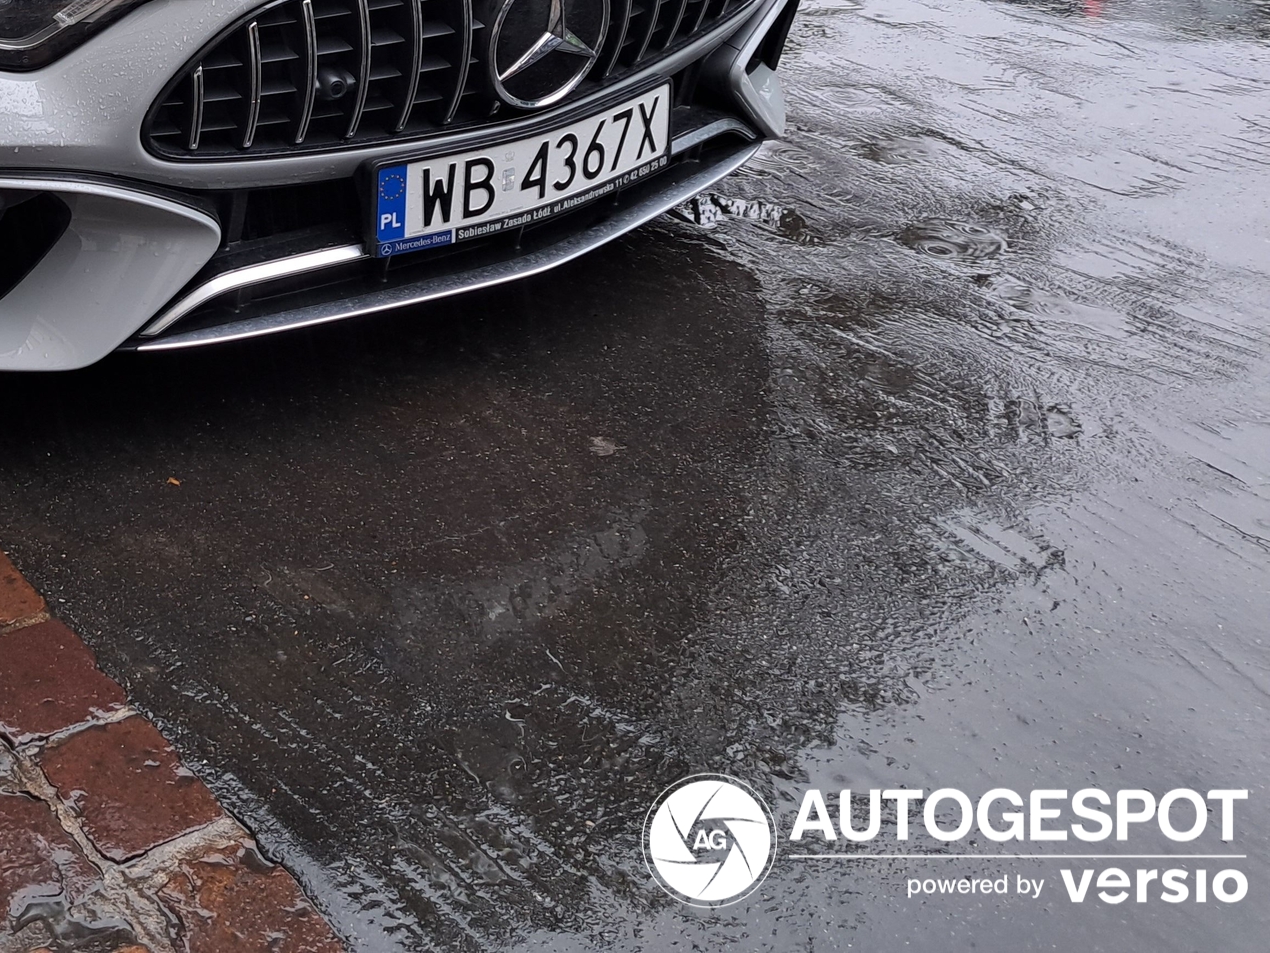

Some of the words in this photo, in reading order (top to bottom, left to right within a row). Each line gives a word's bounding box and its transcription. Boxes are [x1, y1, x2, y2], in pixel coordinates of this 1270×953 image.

[422, 157, 497, 228] WB
[520, 94, 661, 200] 4367X
[380, 212, 402, 231] PL
[458, 221, 502, 240] Sobiesław
[502, 212, 532, 228] Zasada
[614, 176, 623, 188] 11
[394, 234, 451, 252] Mercedes-Benz
